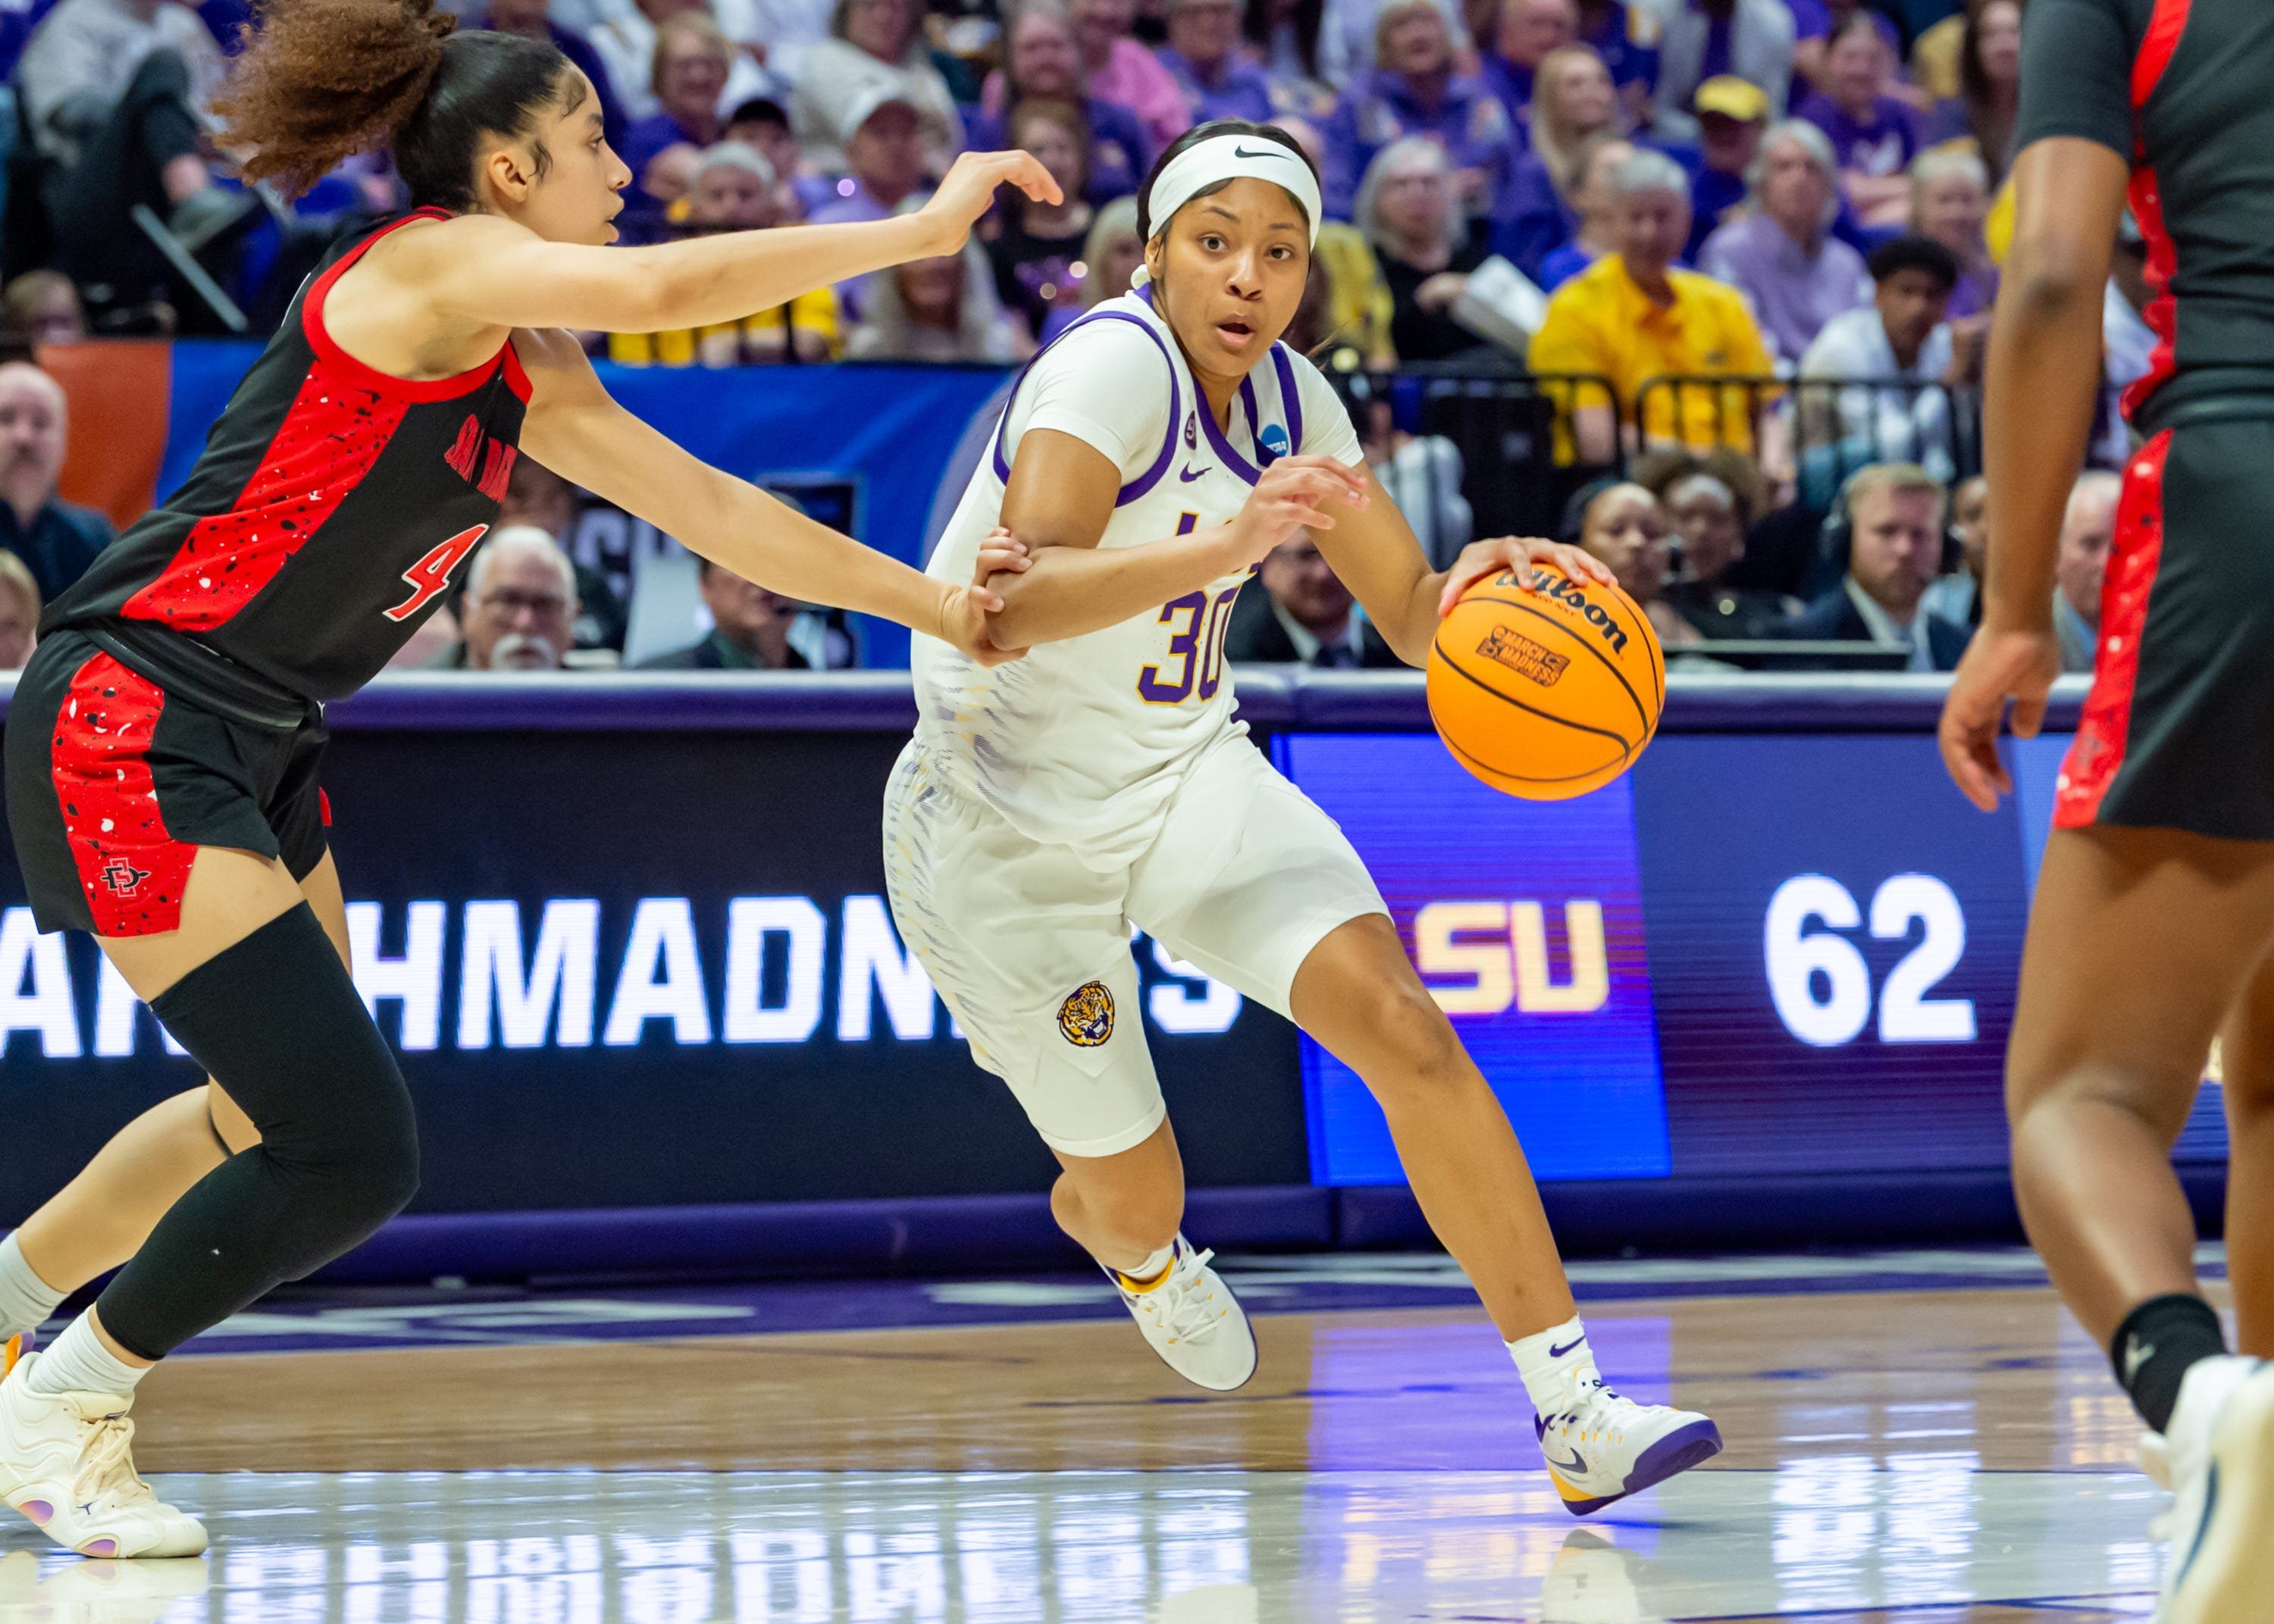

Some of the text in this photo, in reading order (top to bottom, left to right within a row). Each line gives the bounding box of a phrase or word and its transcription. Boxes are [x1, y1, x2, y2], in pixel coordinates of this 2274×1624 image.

[382, 523, 490, 622] 4
[1136, 582, 1244, 706] 30
[1499, 644, 1561, 685] MADNESS
[1501, 629, 1546, 662] MARCH
[1414, 900, 1609, 1014] SU
[1764, 872, 1977, 1047] 62
